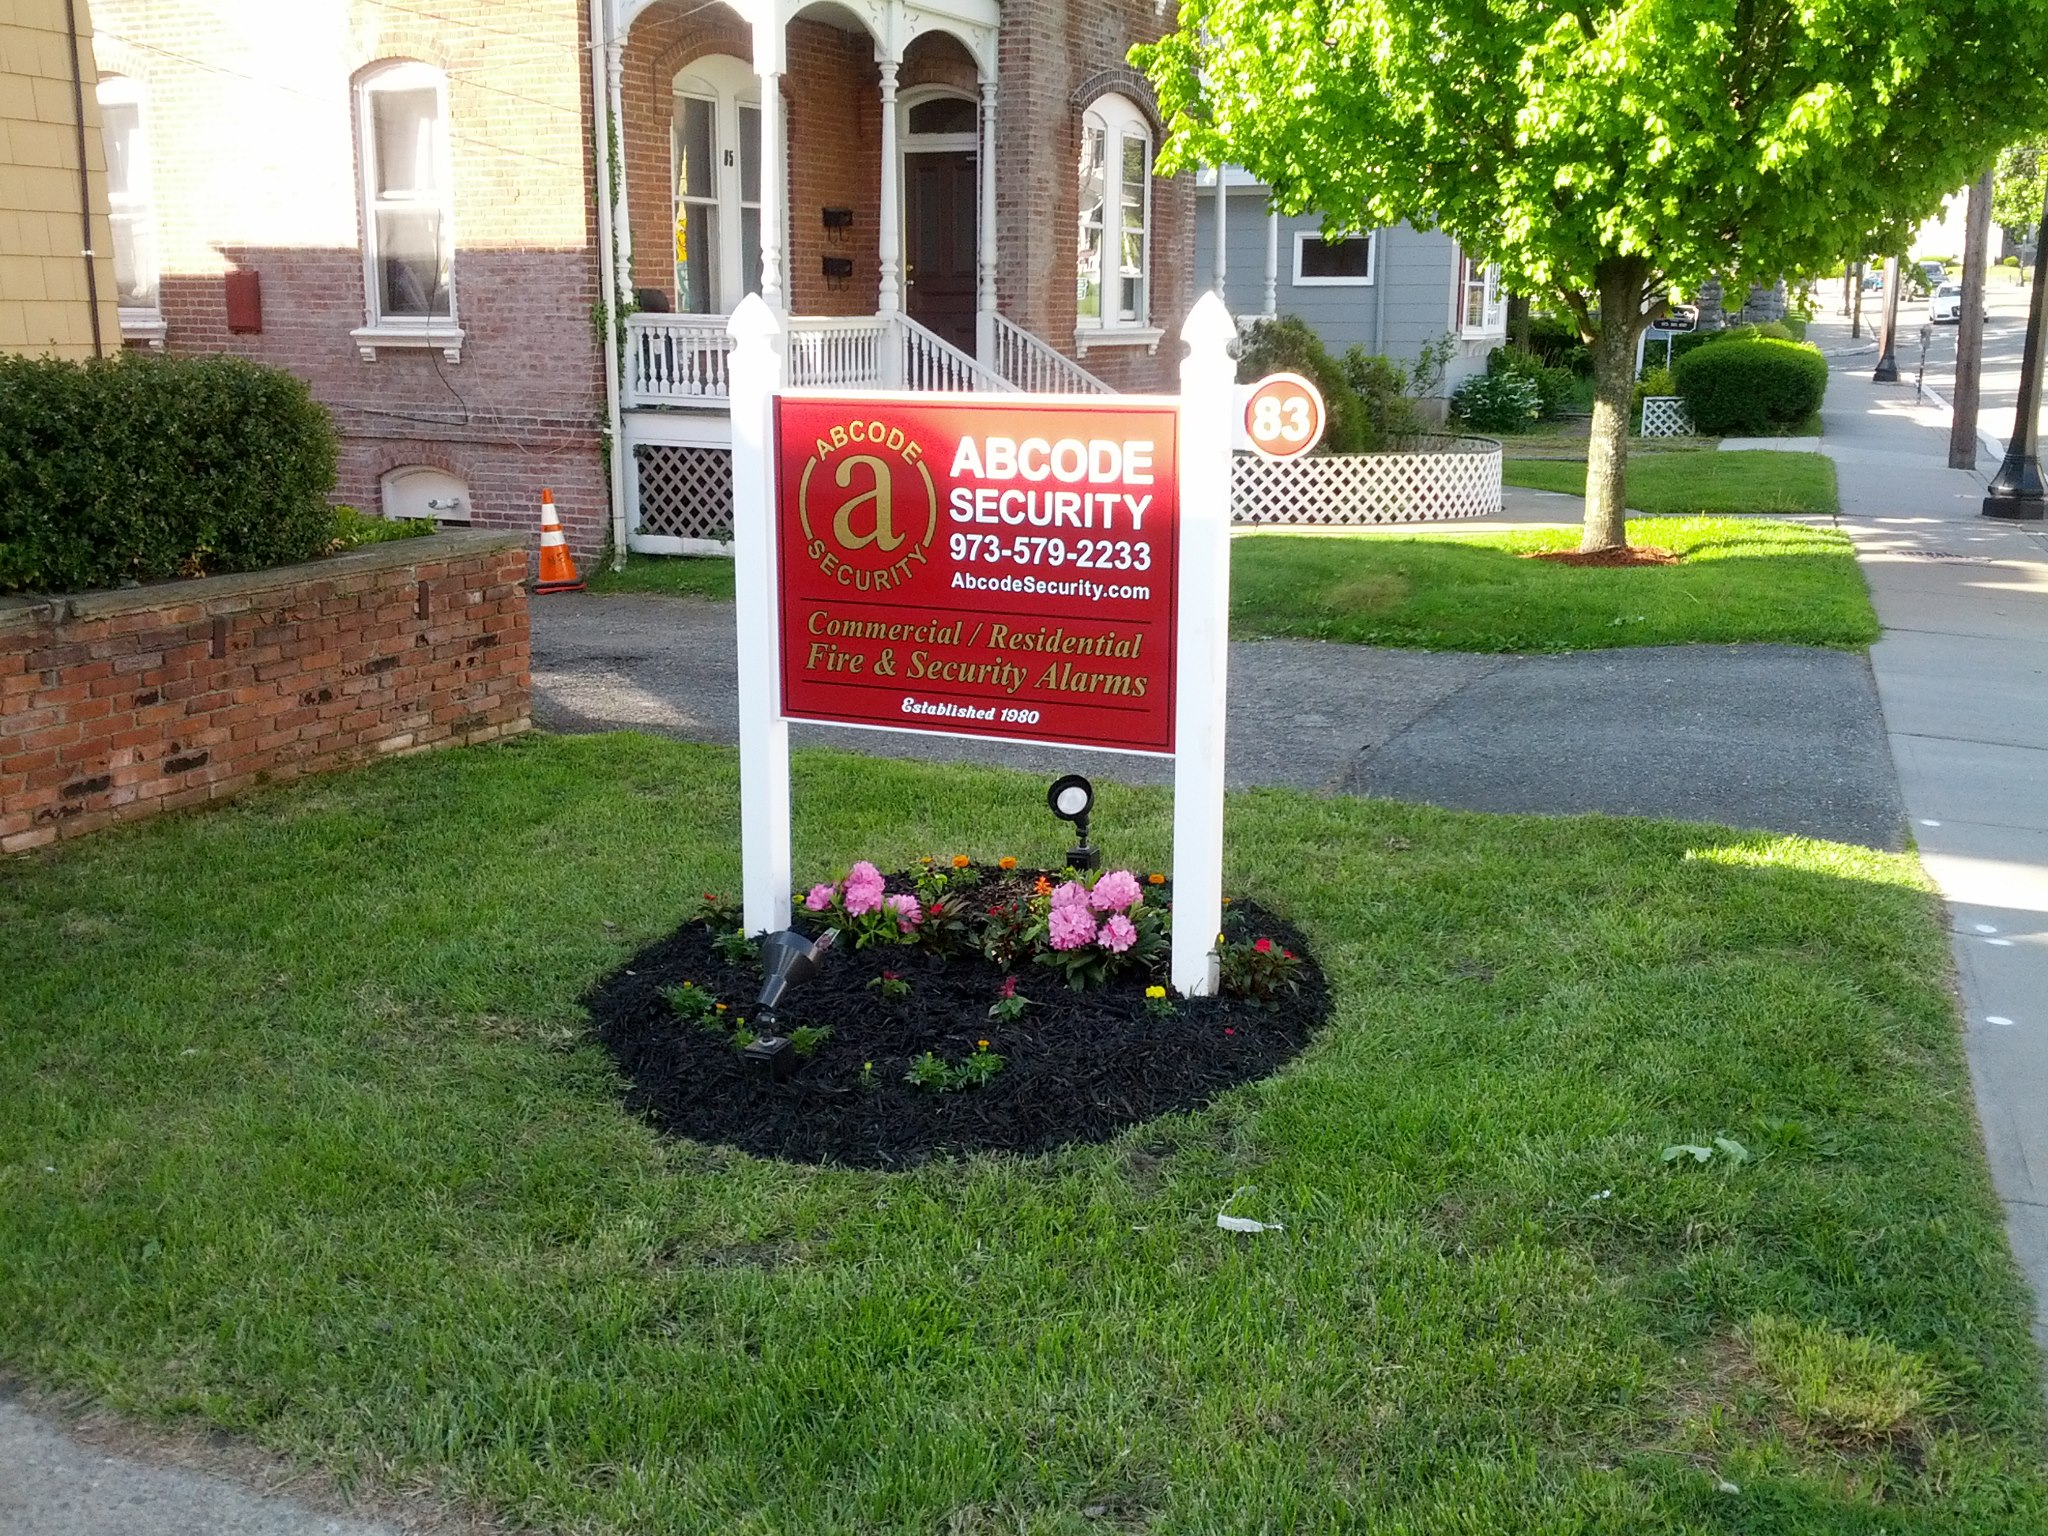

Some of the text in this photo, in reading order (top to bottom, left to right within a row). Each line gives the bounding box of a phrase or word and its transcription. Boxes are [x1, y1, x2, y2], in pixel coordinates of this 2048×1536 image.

[1253, 396, 1311, 442] 83
[815, 420, 923, 466] ABCODE
[949, 435, 1155, 485] ABCODE
[832, 454, 906, 552] a
[949, 487, 1153, 530] SECURITY
[807, 539, 928, 592] SECURITY
[949, 532, 1152, 571] 973-579-2233
[950, 571, 1151, 601] AbcodeSecurity.com
[807, 610, 964, 646] Commercial
[987, 623, 1144, 659] Residential
[805, 642, 1149, 697] Fire & Security Alarms
[901, 697, 1040, 724] Established 1980
